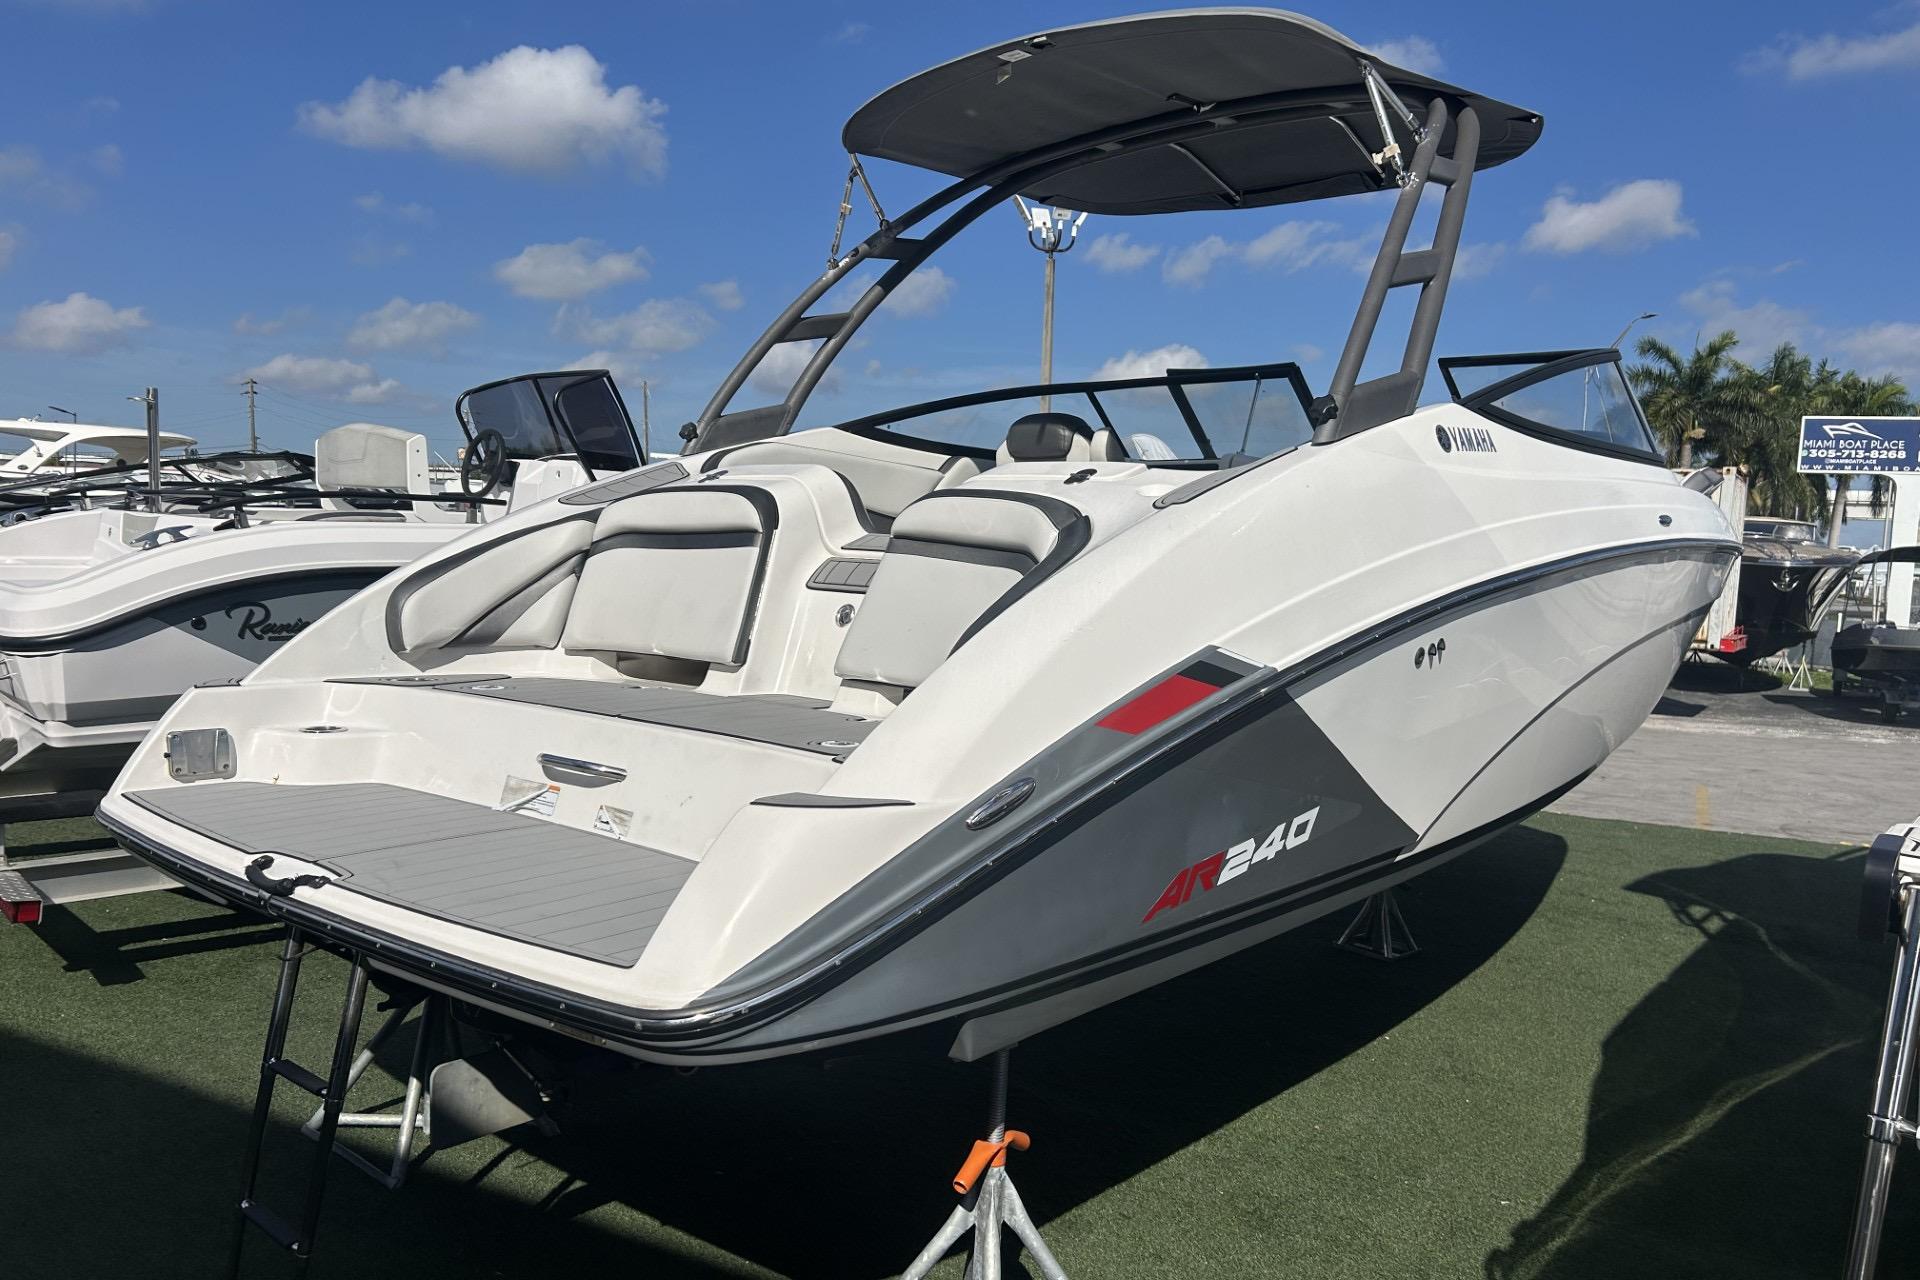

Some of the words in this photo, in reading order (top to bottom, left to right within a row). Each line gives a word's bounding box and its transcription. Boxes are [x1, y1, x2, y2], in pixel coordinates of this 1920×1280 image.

[1447, 426, 1497, 452] YAMAHA
[1803, 440, 1836, 449] MIAMI
[1839, 440, 1868, 449] BOAT
[1870, 440, 1906, 449] PLACE
[1808, 449, 1906, 459] 305-713-8268
